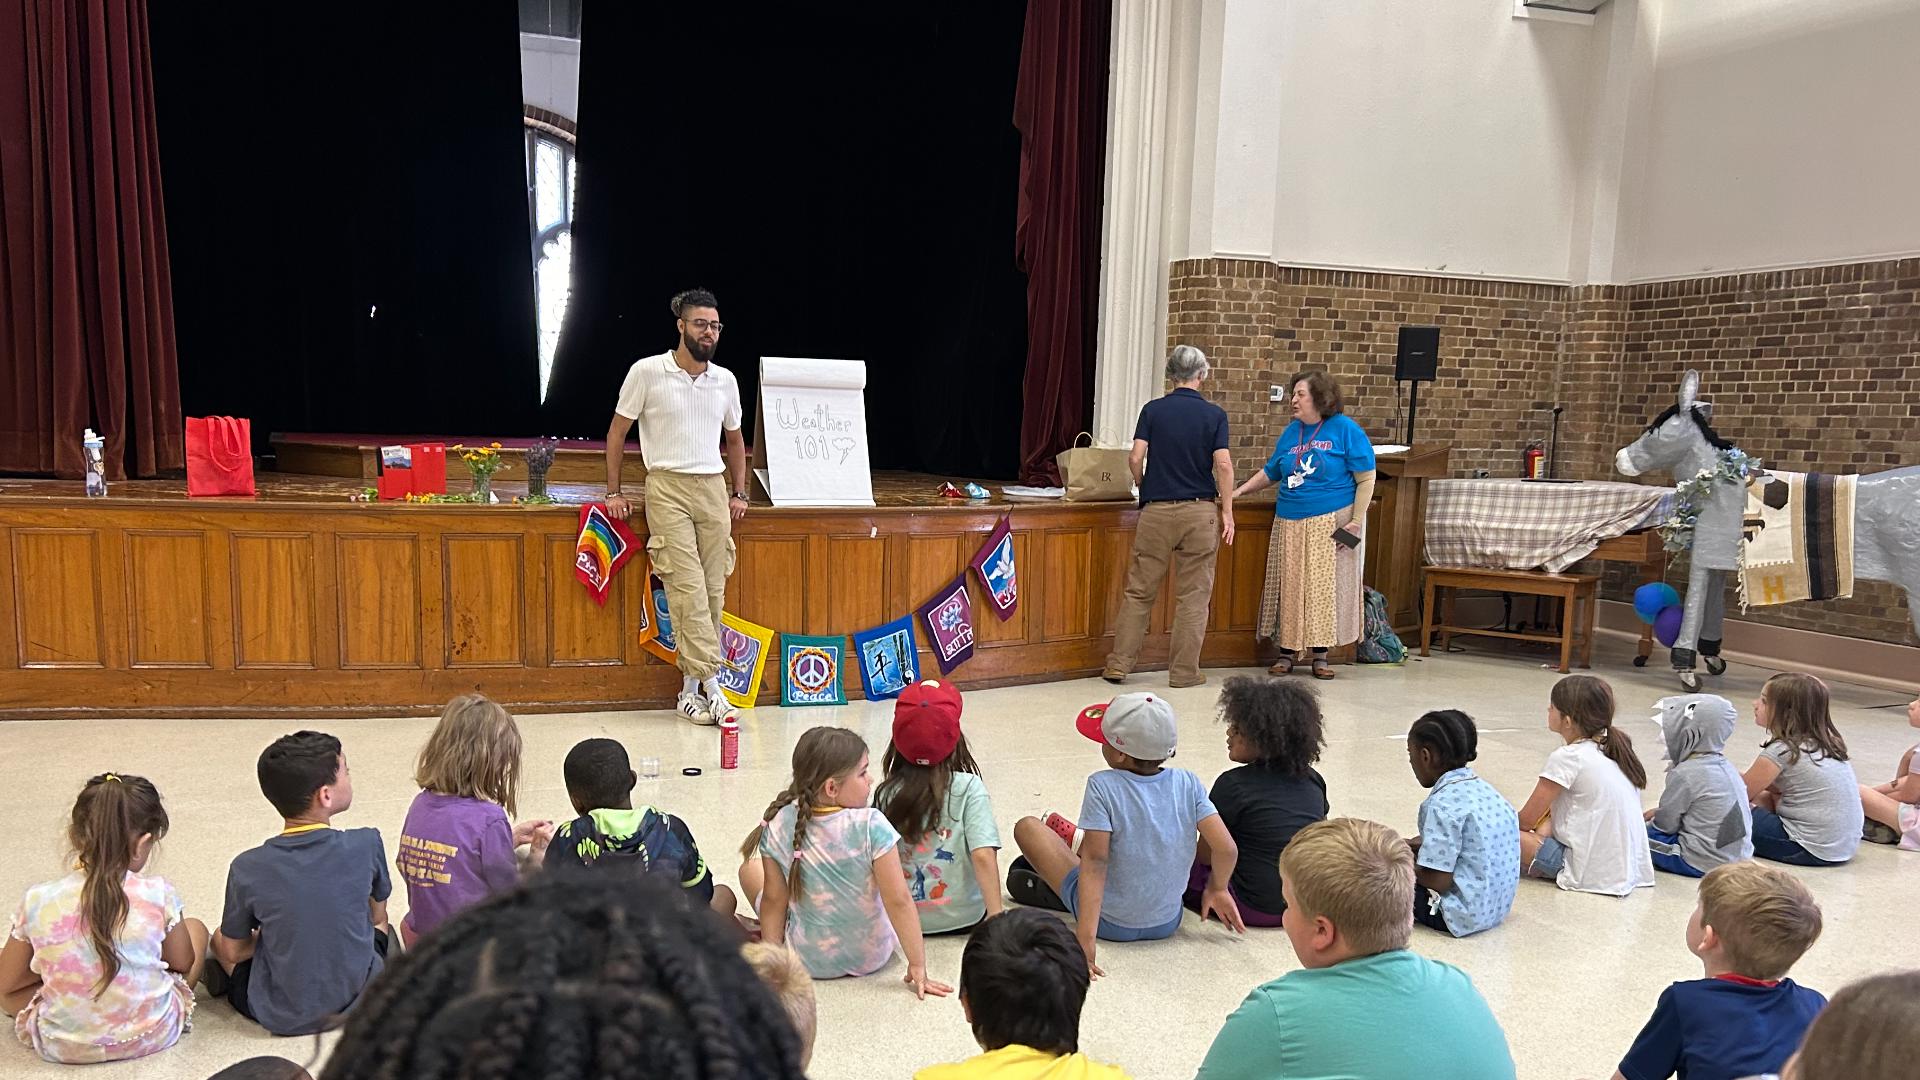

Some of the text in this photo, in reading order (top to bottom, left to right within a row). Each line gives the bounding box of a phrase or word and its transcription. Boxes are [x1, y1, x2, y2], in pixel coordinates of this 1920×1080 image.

[775, 398, 852, 432] Weather
[795, 435, 830, 460] 101
[1761, 574, 1786, 604] H
[792, 690, 832, 701] Peace
